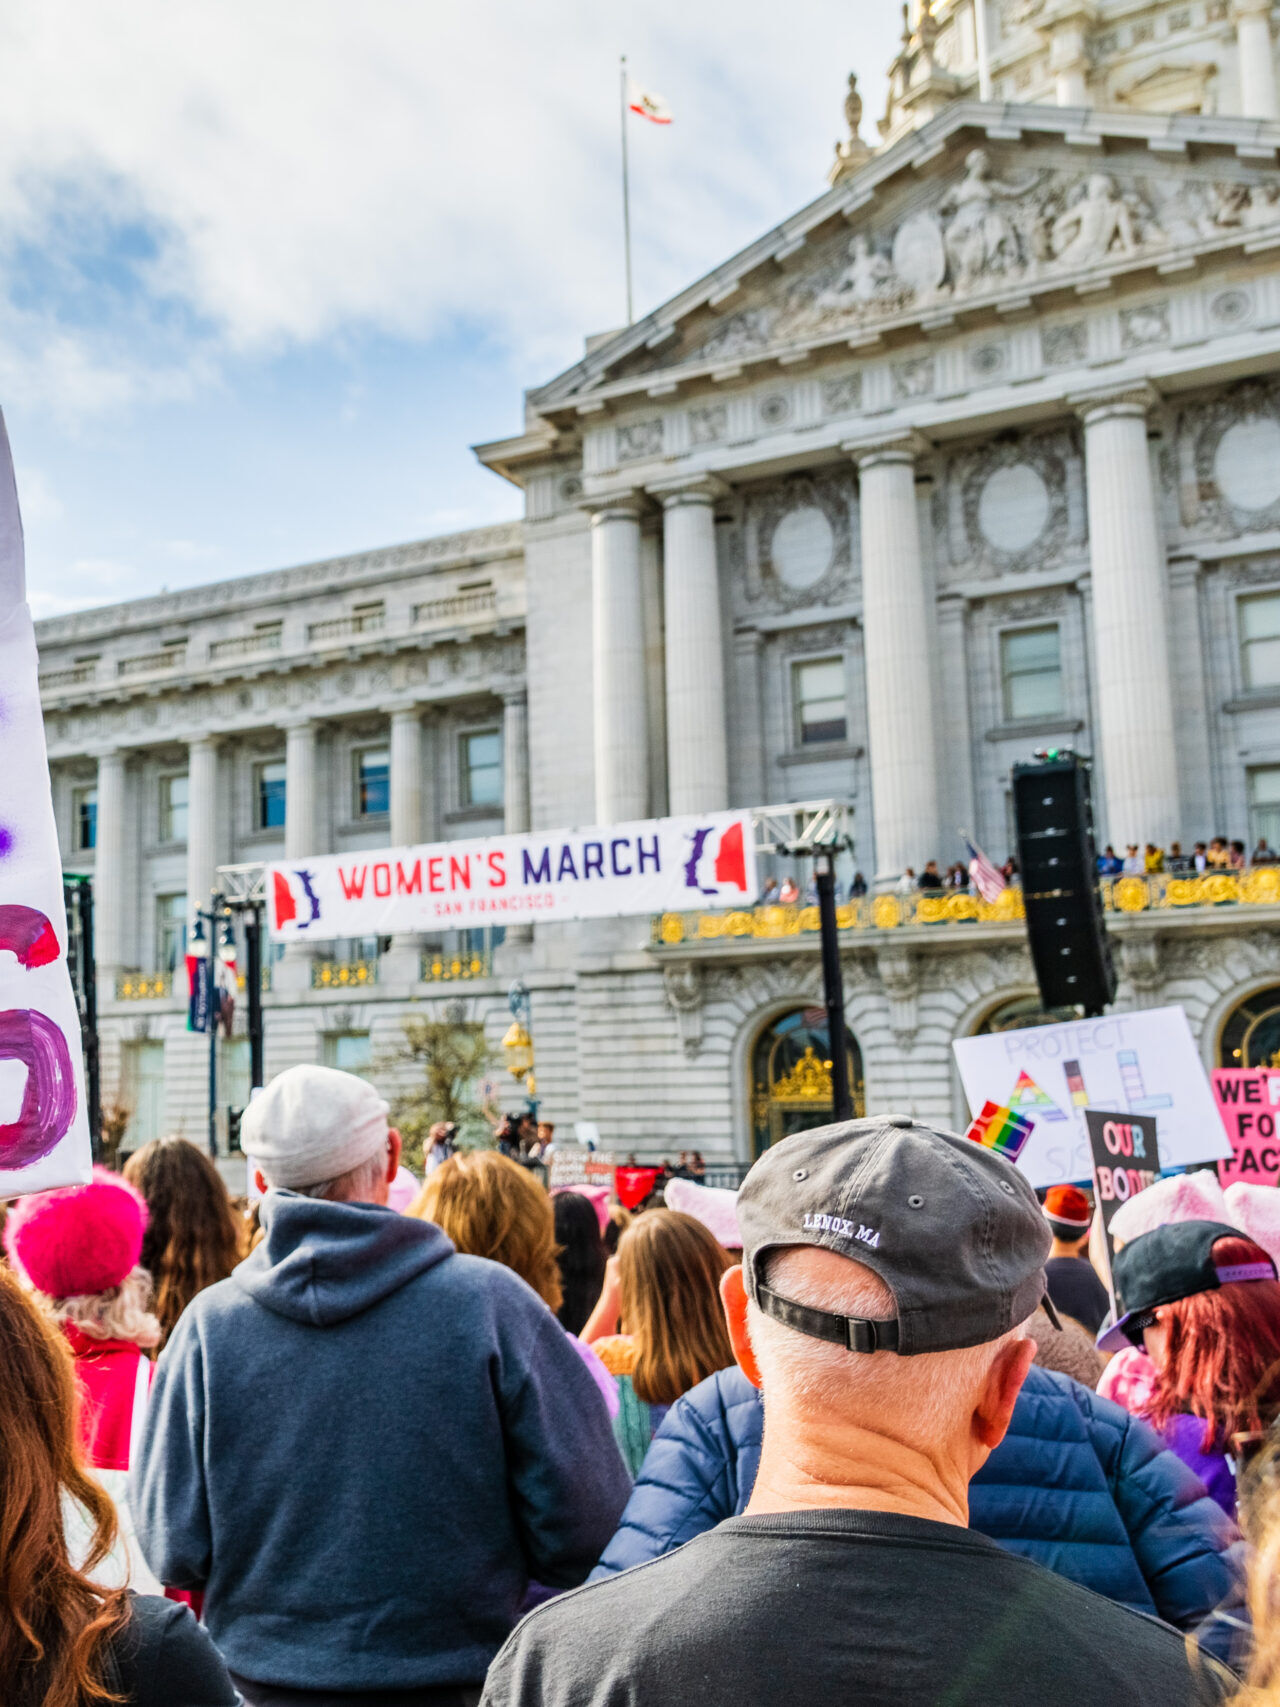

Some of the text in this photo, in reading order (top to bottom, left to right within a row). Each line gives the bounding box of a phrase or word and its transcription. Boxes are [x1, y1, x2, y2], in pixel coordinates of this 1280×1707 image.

[338, 835, 661, 900] WOMEN'S MARCH
[435, 893, 555, 917] SAN FRANCISCO
[1003, 1018, 1129, 1063] PROTECT
[1007, 1049, 1173, 1122] ALL
[1103, 1121, 1146, 1158] OUR
[1237, 1111, 1280, 1140] FO
[1224, 1147, 1280, 1172] FAC
[803, 1213, 880, 1248] LENOX, MA
